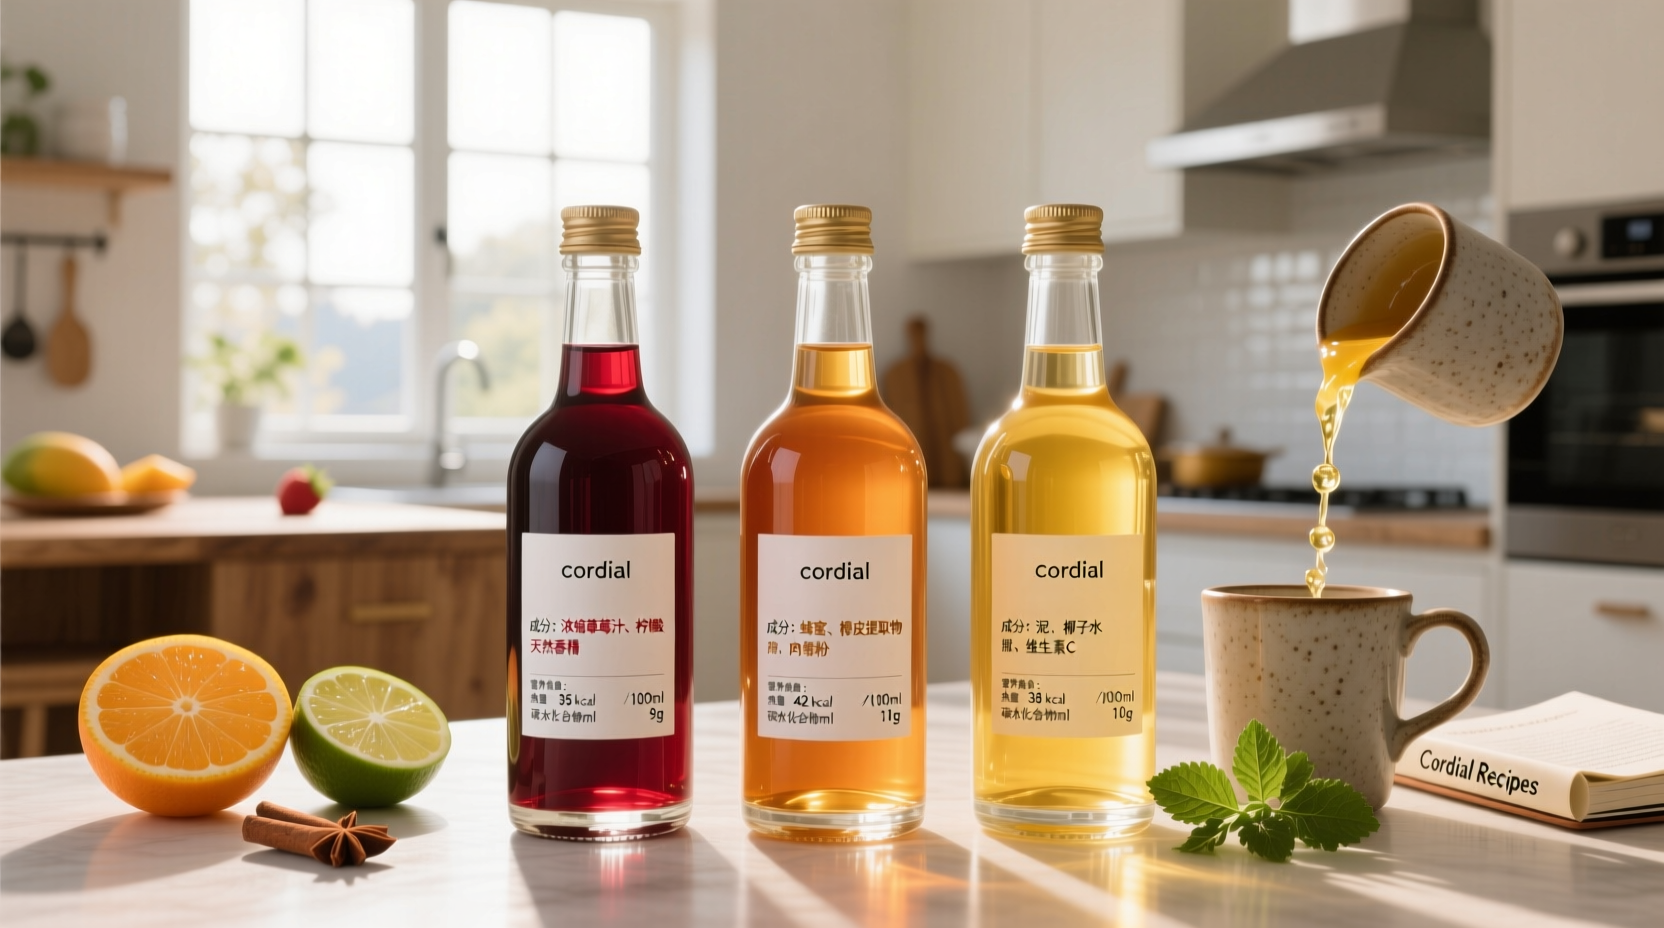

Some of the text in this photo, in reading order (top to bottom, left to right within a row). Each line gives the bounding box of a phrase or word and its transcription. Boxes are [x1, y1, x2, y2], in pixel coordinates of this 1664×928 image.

[561, 560, 631, 579] cordial
[800, 561, 870, 580] cordial
[1035, 560, 1104, 579] cordial
[559, 693, 572, 706] 35
[793, 695, 809, 708] 42
[811, 695, 833, 708] kcal
[1028, 691, 1042, 704] 38
[1045, 692, 1066, 705] kcal
[649, 707, 664, 723] 9g
[881, 709, 901, 725] 11g
[1113, 706, 1133, 722] 10g
[1420, 749, 1539, 795] Cordial Recipes
